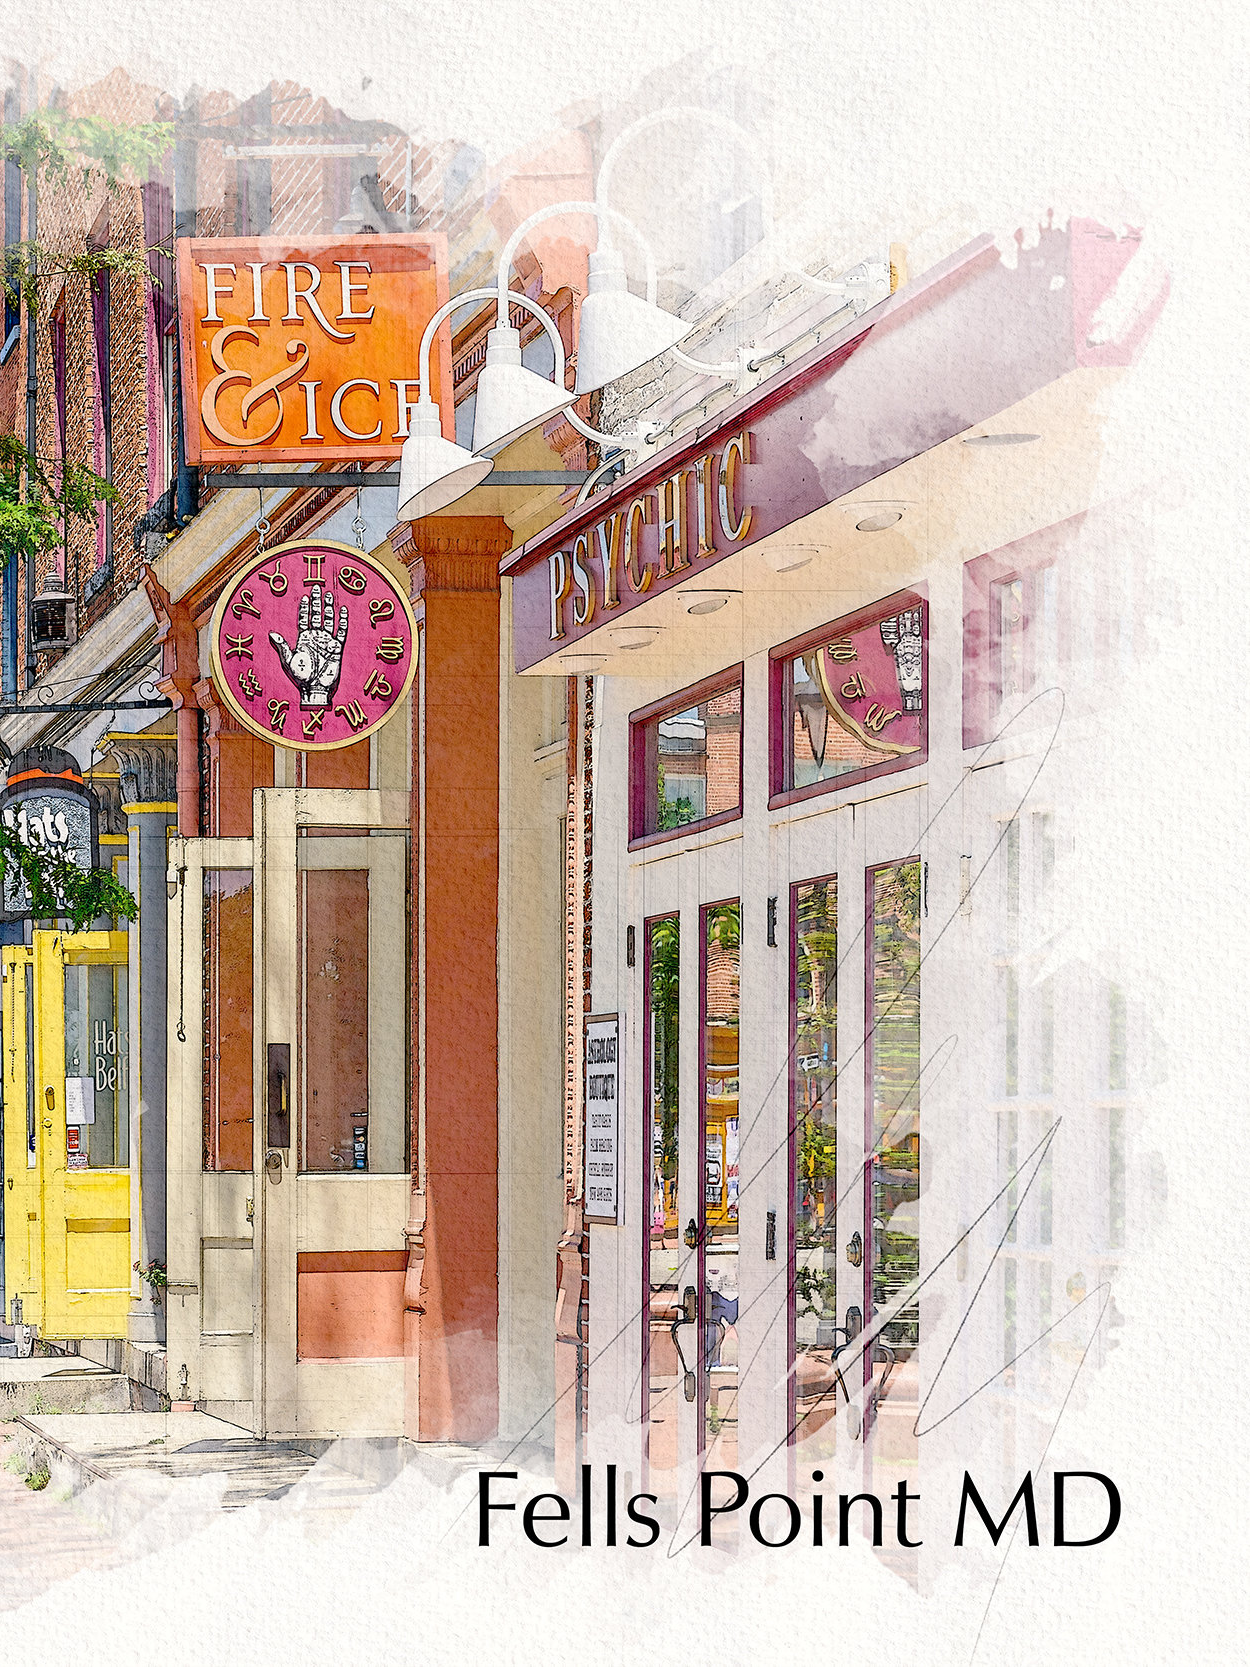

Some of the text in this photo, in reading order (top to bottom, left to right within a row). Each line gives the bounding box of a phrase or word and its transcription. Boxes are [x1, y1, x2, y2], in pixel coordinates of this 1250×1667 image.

[199, 260, 376, 340] FIRE
[201, 325, 309, 447] &
[547, 431, 755, 641] PSYCHIC
